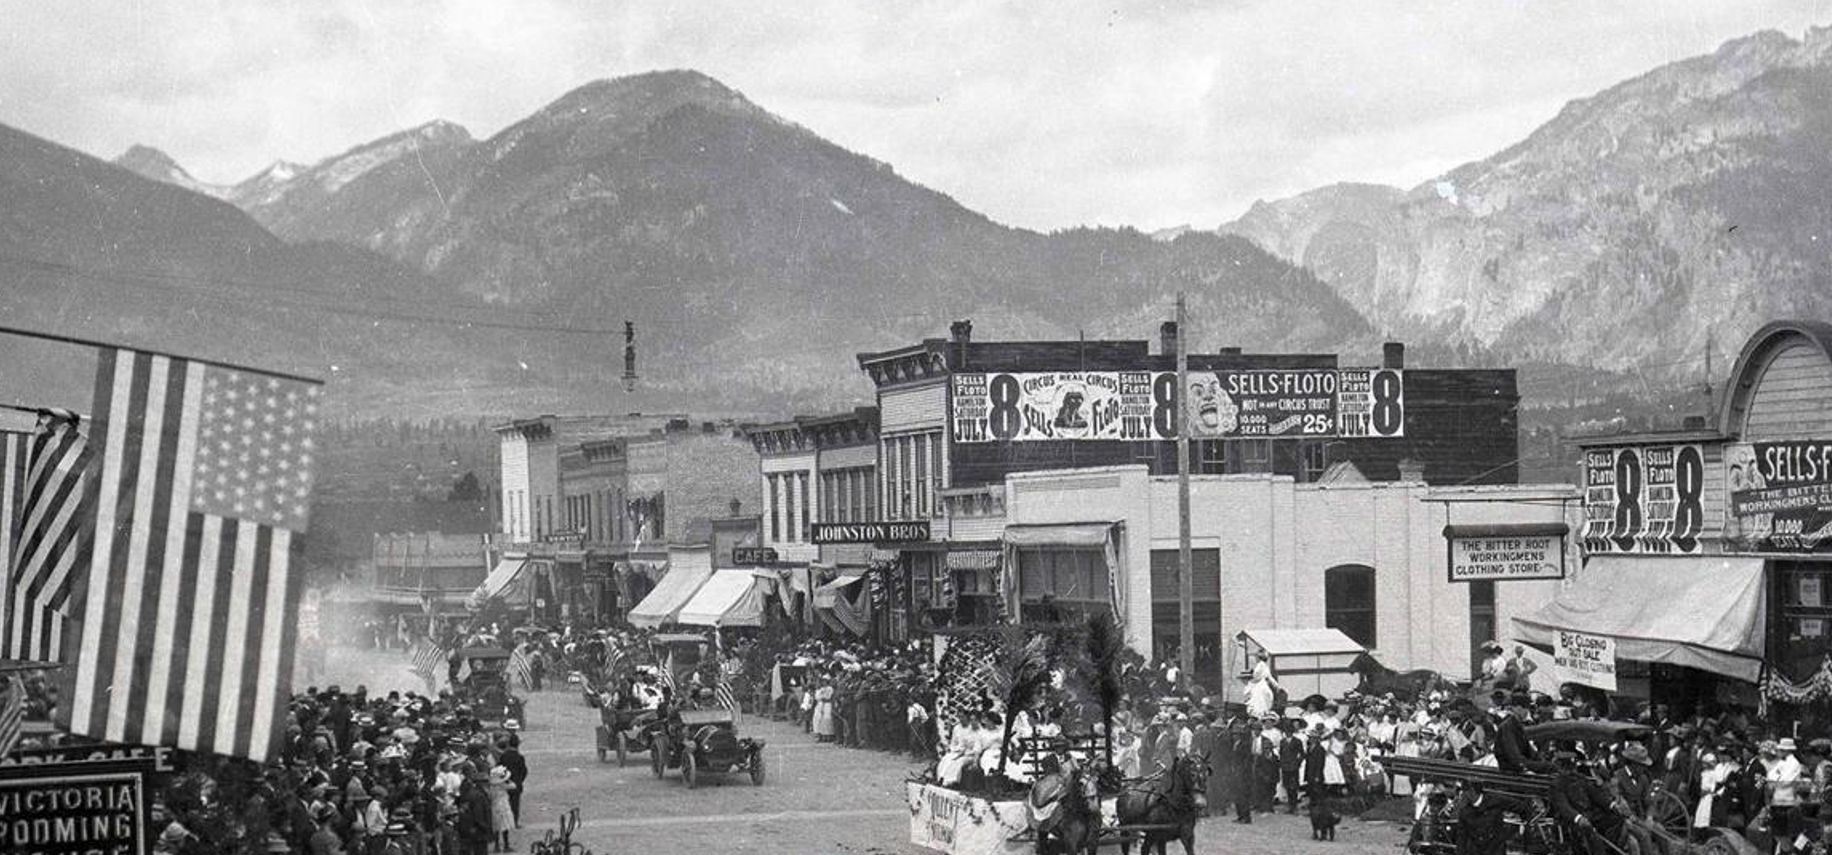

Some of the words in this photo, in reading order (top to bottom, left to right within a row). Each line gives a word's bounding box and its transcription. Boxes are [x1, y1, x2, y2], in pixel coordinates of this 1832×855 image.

[956, 375, 985, 385] SELLS
[1023, 375, 1055, 395] CIRCUS
[1059, 374, 1084, 382] REAL
[1086, 374, 1118, 394] CIRCUS
[1121, 374, 1149, 384] SELLS
[1340, 372, 1368, 382] SELLS
[957, 385, 987, 395] FLOTO
[1122, 384, 1151, 394] FLOTO
[989, 374, 1021, 440] 8
[1153, 373, 1178, 440] 8
[1278, 398, 1307, 411] CIRCUS
[1372, 370, 1402, 436] 8
[1023, 403, 1054, 438] SELLS
[1120, 416, 1152, 439] JULY
[955, 418, 988, 441] JULY
[1588, 453, 1612, 467] SELLS
[1647, 450, 1672, 466] SELLS
[1589, 468, 1614, 485] FLOTO
[1649, 467, 1675, 483] FLOTO
[1613, 449, 1642, 552] 8
[1673, 446, 1703, 553] 8
[815, 525, 885, 541] JOHNSTON
[889, 524, 927, 539] BROS
[1461, 540, 1482, 550] THE
[1486, 540, 1522, 550] BITTER
[1525, 539, 1551, 550] ROOT
[734, 549, 773, 564] CAFE
[1469, 551, 1545, 562] WORKINGMENS
[1455, 563, 1505, 575] CLOTHING
[1508, 563, 1541, 574] STORE
[1575, 634, 1607, 650] CLOSING
[1583, 649, 1601, 661] SALE
